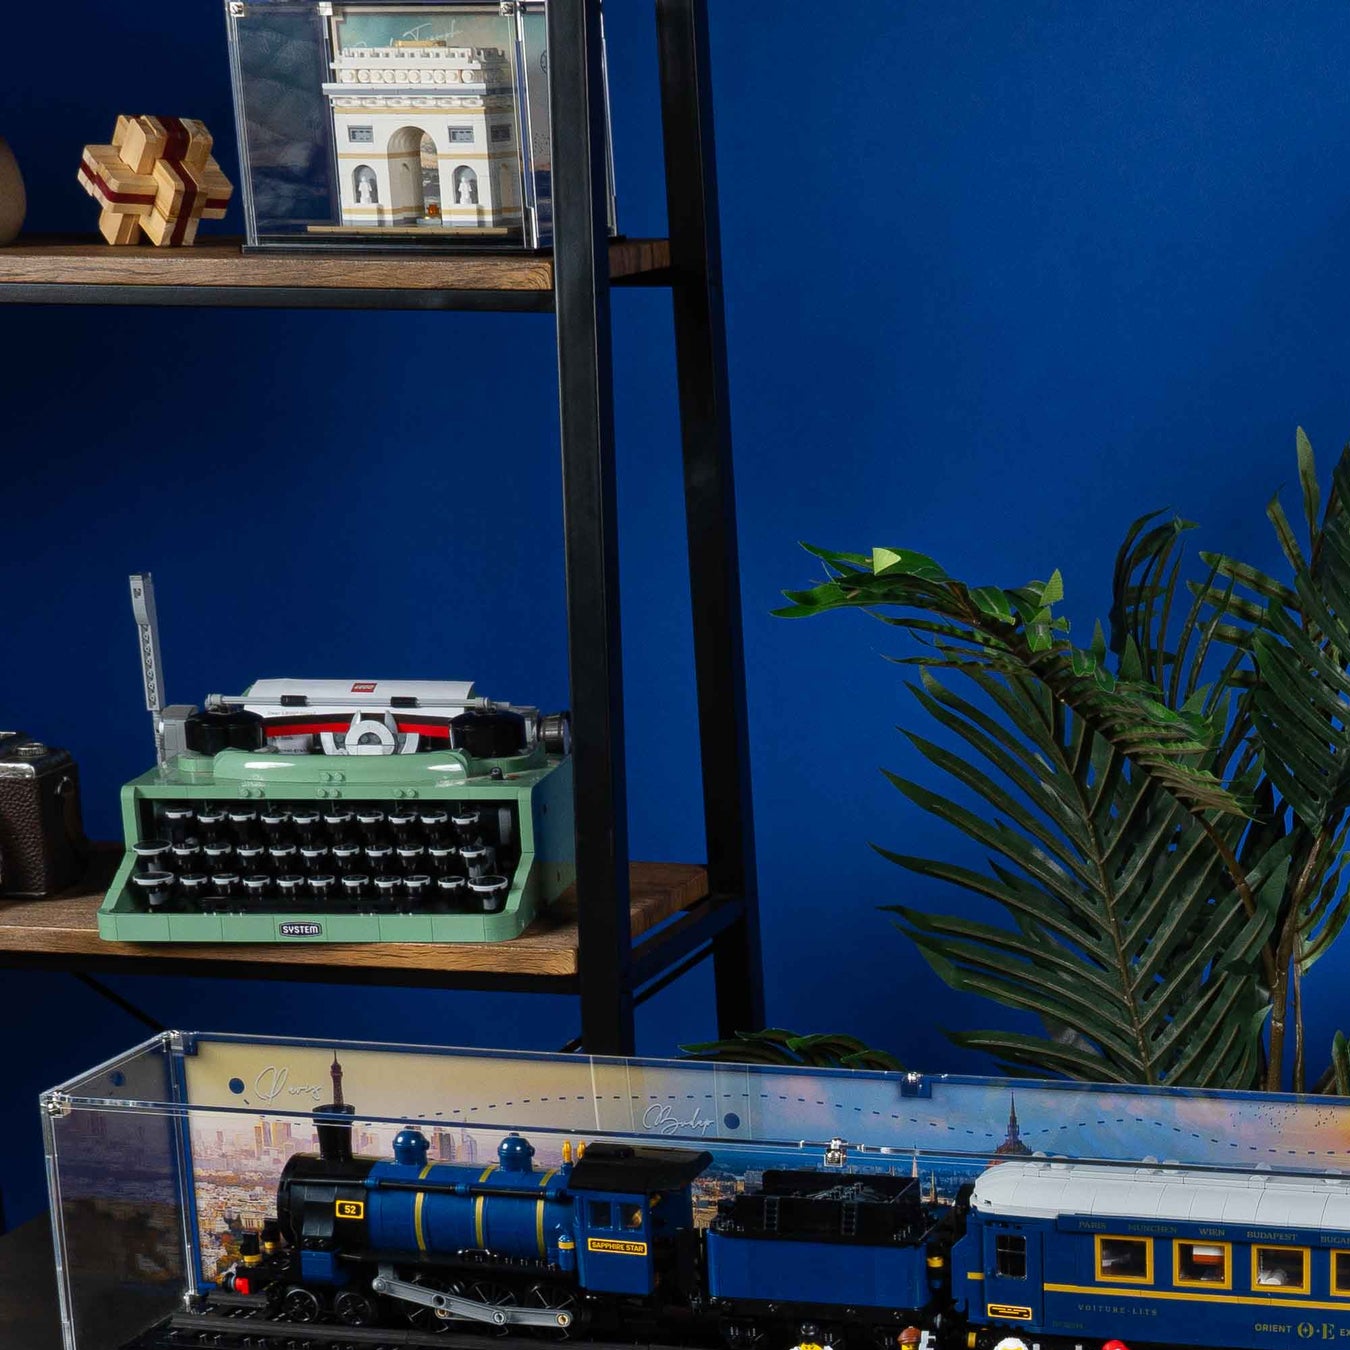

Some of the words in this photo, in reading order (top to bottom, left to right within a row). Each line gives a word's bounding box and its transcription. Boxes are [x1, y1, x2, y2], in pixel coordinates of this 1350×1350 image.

[282, 925, 319, 934] SYSTEM
[344, 1204, 357, 1215] 52
[1078, 1221, 1107, 1230] PARIS
[1199, 1227, 1225, 1237] WIEN
[1246, 1231, 1298, 1241] BUDAPEST
[591, 1241, 625, 1251] SAPPHIRE
[625, 1244, 644, 1252] STAR
[1254, 1323, 1292, 1333] ORIENT
